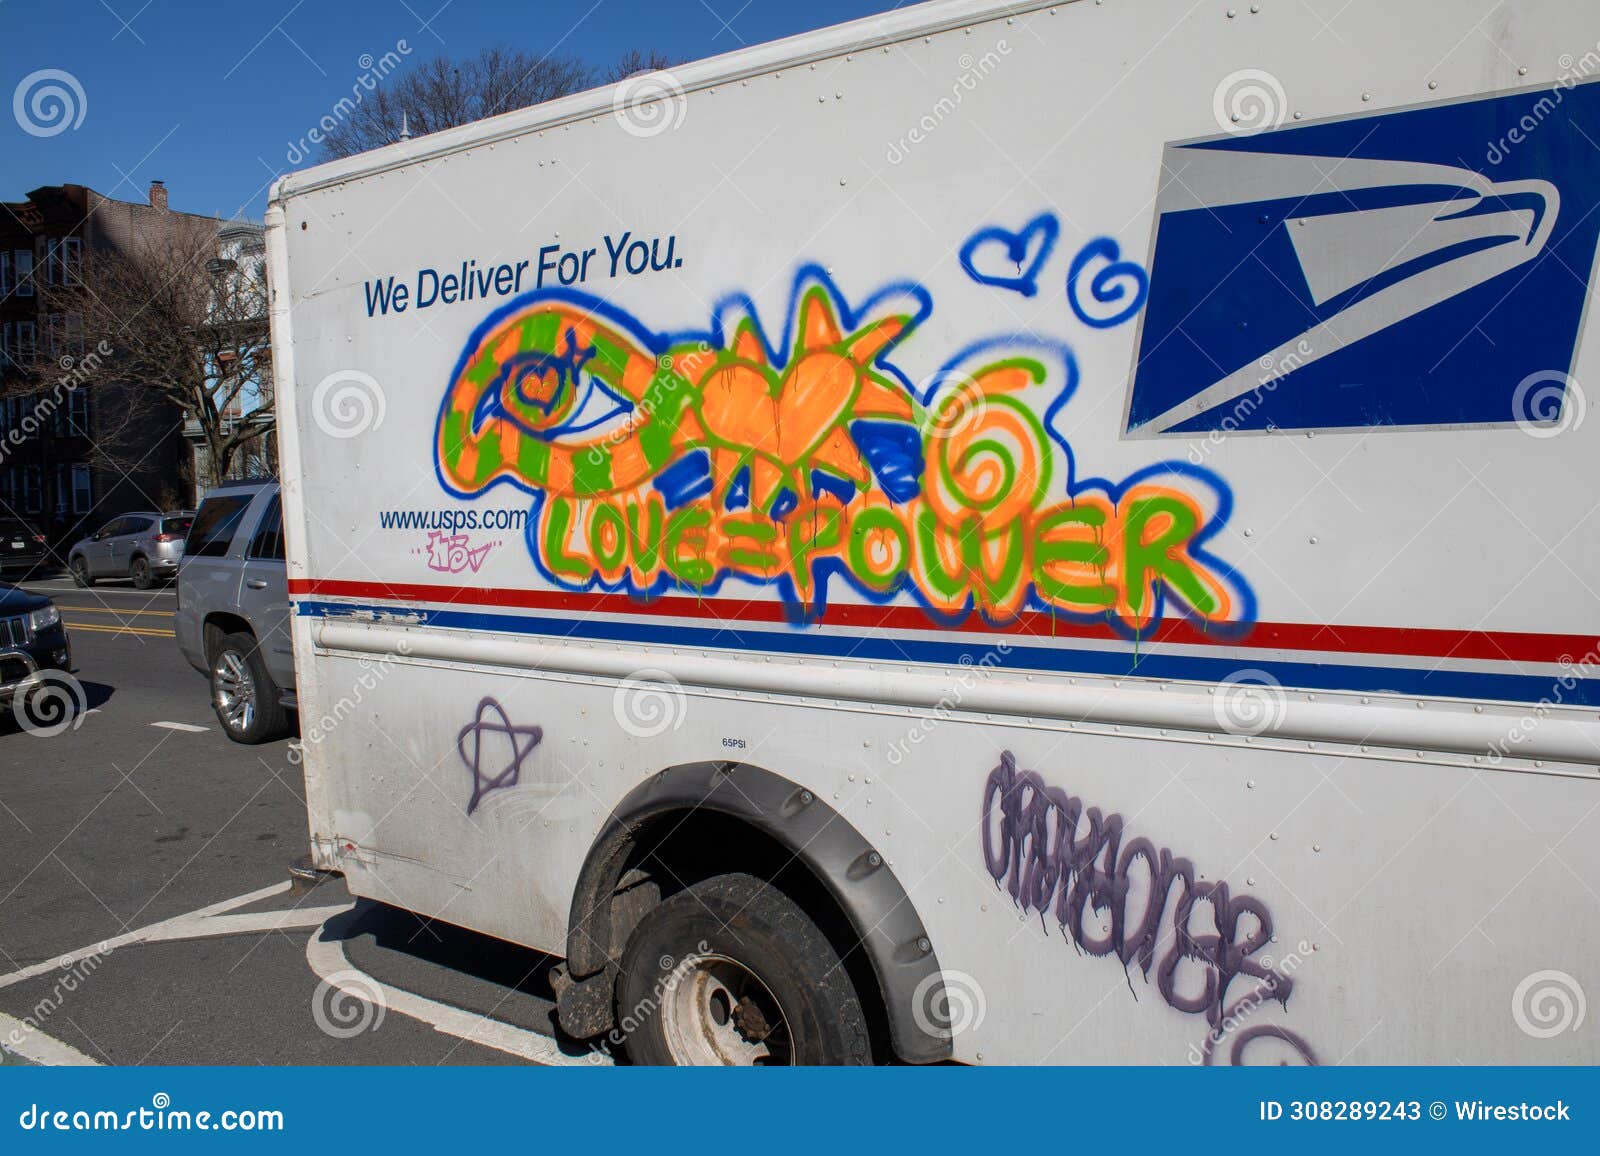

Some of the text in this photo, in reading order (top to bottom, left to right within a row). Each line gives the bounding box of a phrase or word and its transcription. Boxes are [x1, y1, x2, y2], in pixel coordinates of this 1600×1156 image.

[364, 231, 683, 317] We Deliver For You.
[380, 509, 528, 535] www.usps.com
[722, 737, 746, 749] 65PSI
